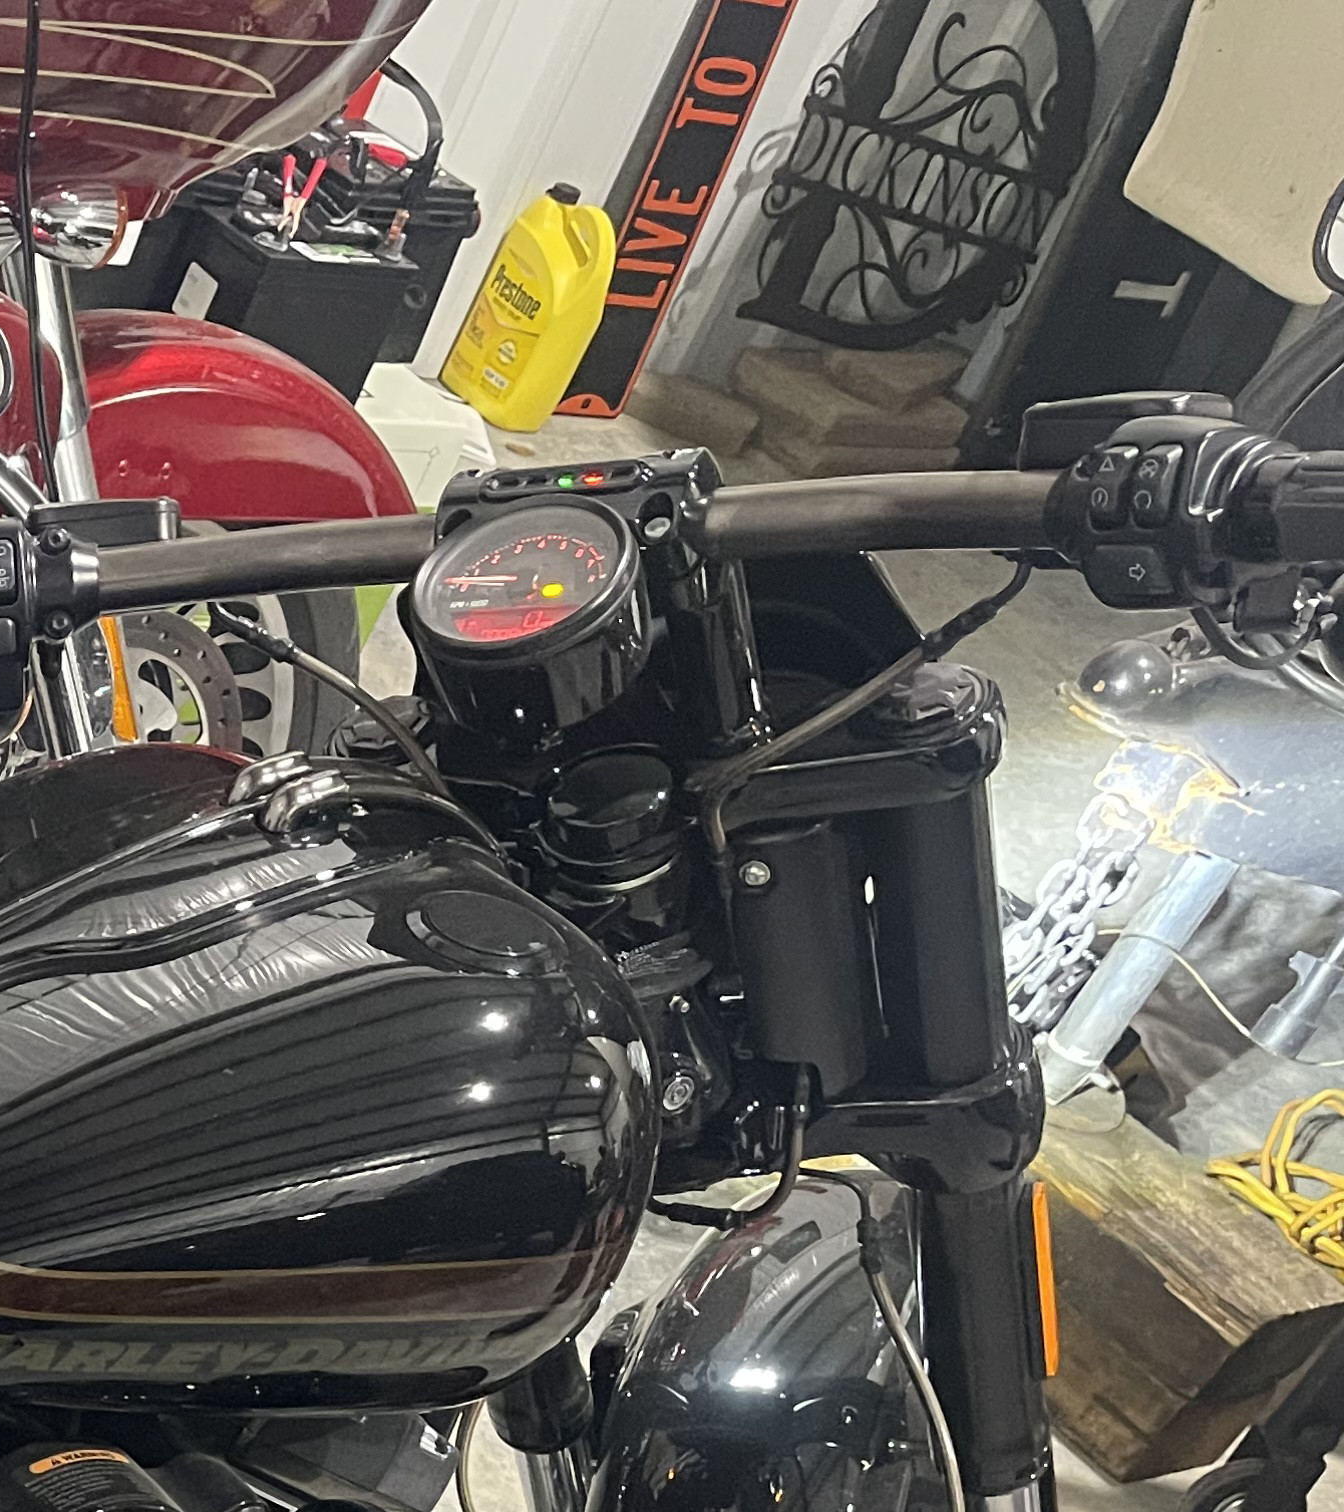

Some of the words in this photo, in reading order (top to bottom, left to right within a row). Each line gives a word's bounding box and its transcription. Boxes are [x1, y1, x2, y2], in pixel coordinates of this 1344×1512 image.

[606, 179, 709, 309] LIVE
[675, 56, 757, 129] TO
[785, 111, 1054, 246] DICKINSON
[490, 264, 542, 321] Prestone
